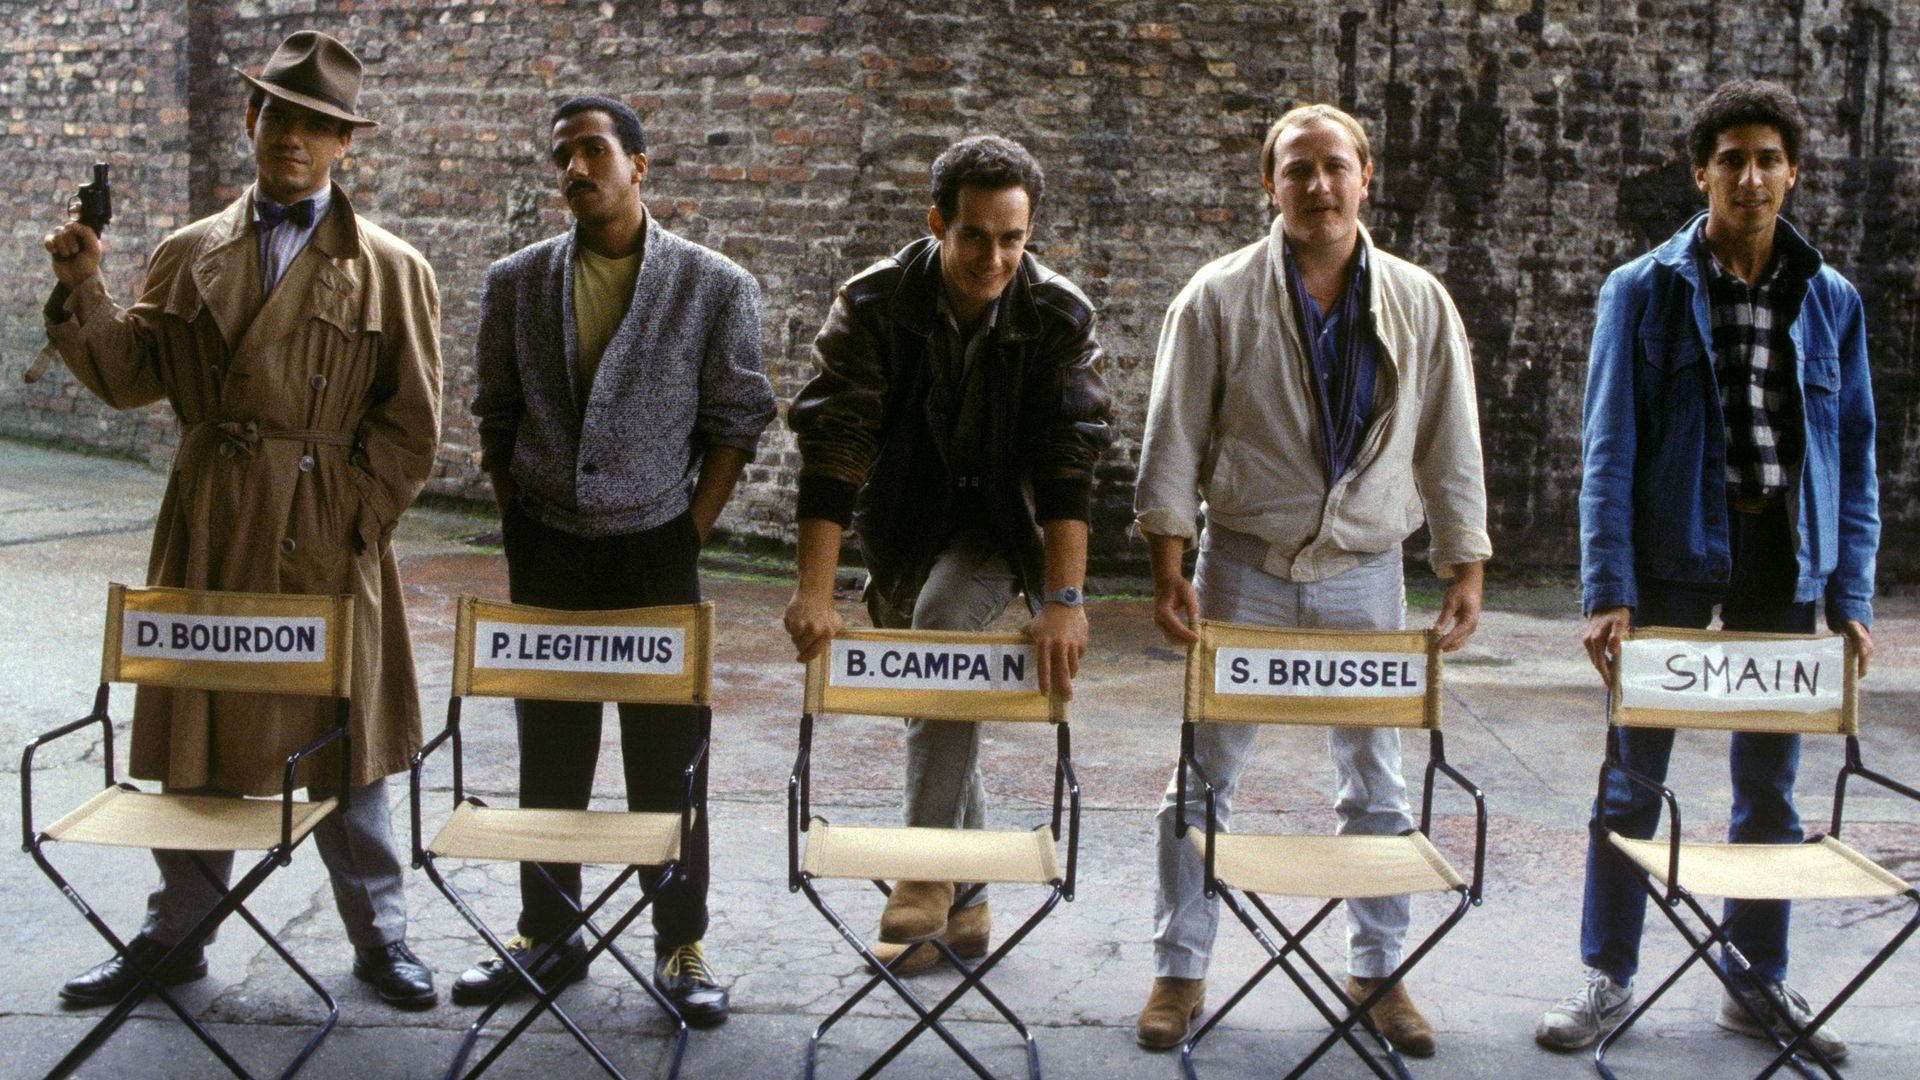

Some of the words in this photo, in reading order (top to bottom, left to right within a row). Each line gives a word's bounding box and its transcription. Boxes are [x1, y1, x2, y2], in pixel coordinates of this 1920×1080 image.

[171, 622, 316, 653] BOURDON
[1230, 657, 1259, 685] S.
[1268, 658, 1417, 688] BRUSSEL
[1661, 653, 1820, 696] SMAIN
